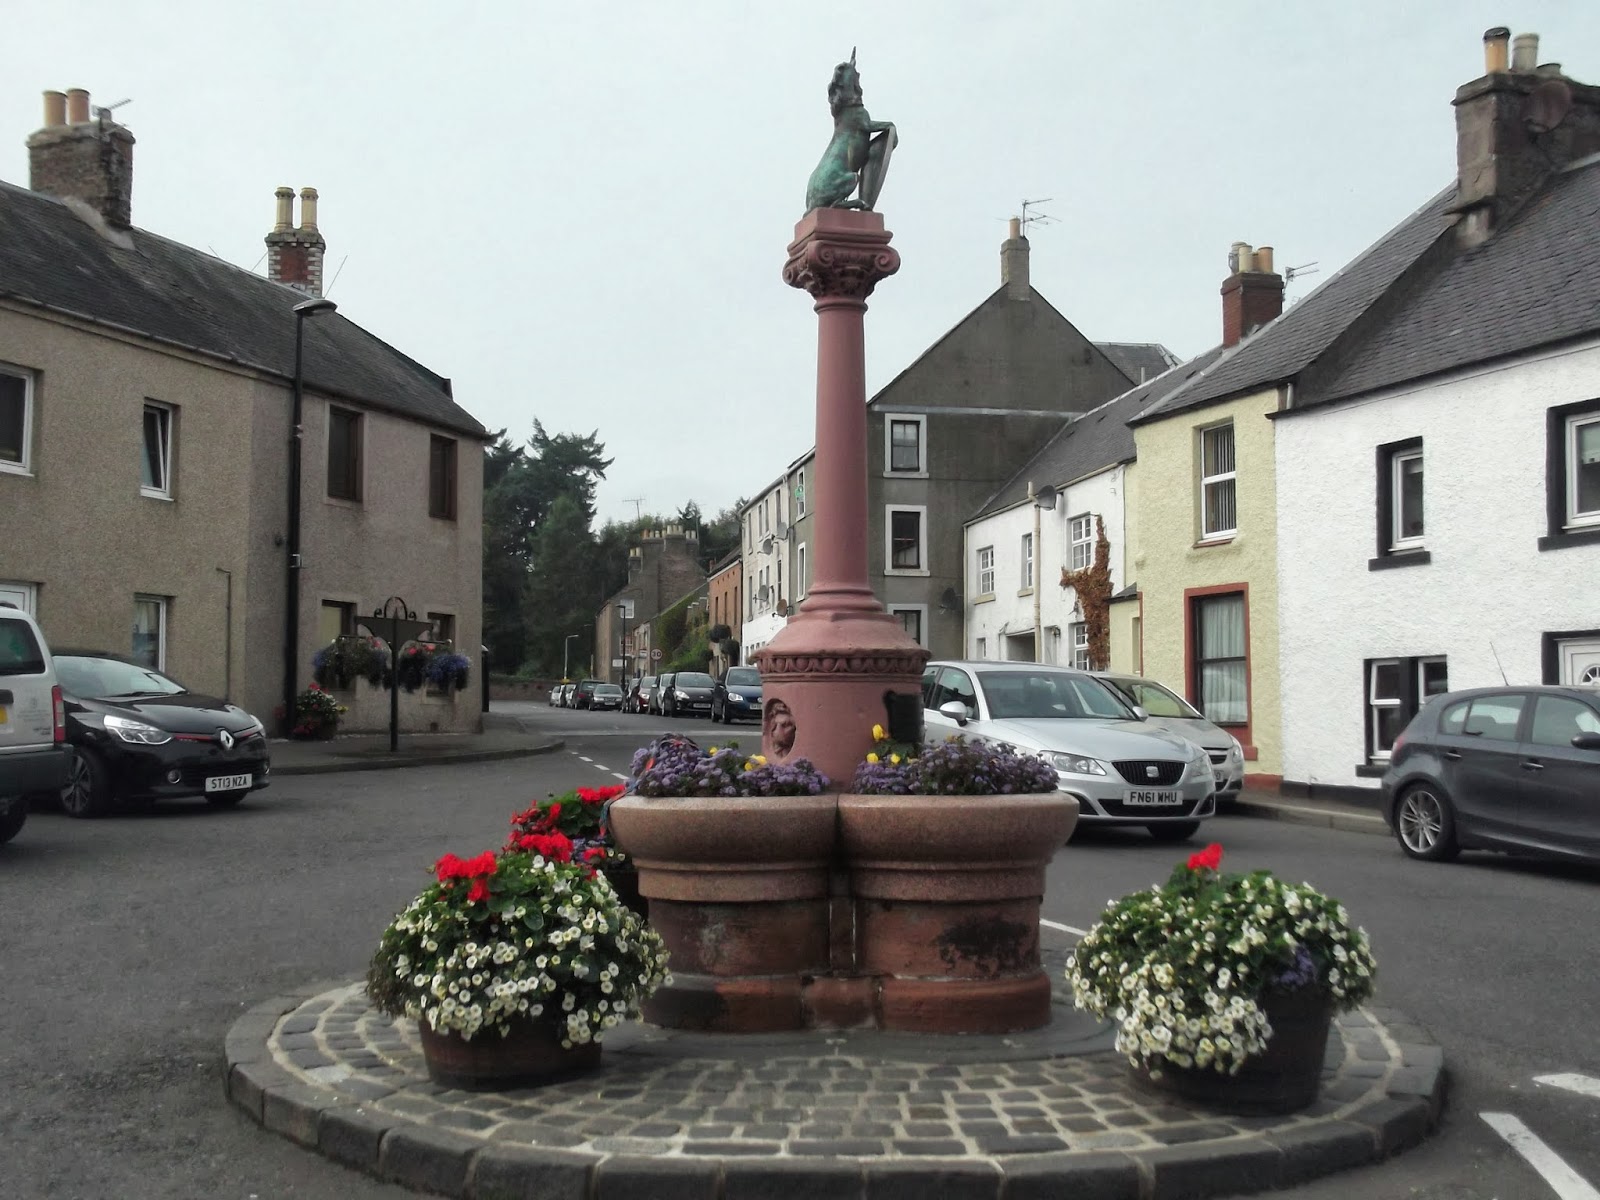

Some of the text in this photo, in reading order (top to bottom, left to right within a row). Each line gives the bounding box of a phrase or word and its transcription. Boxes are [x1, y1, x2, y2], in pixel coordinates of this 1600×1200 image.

[211, 775, 248, 789] ST13 NZA
[1130, 791, 1177, 803] FN61 WHU
